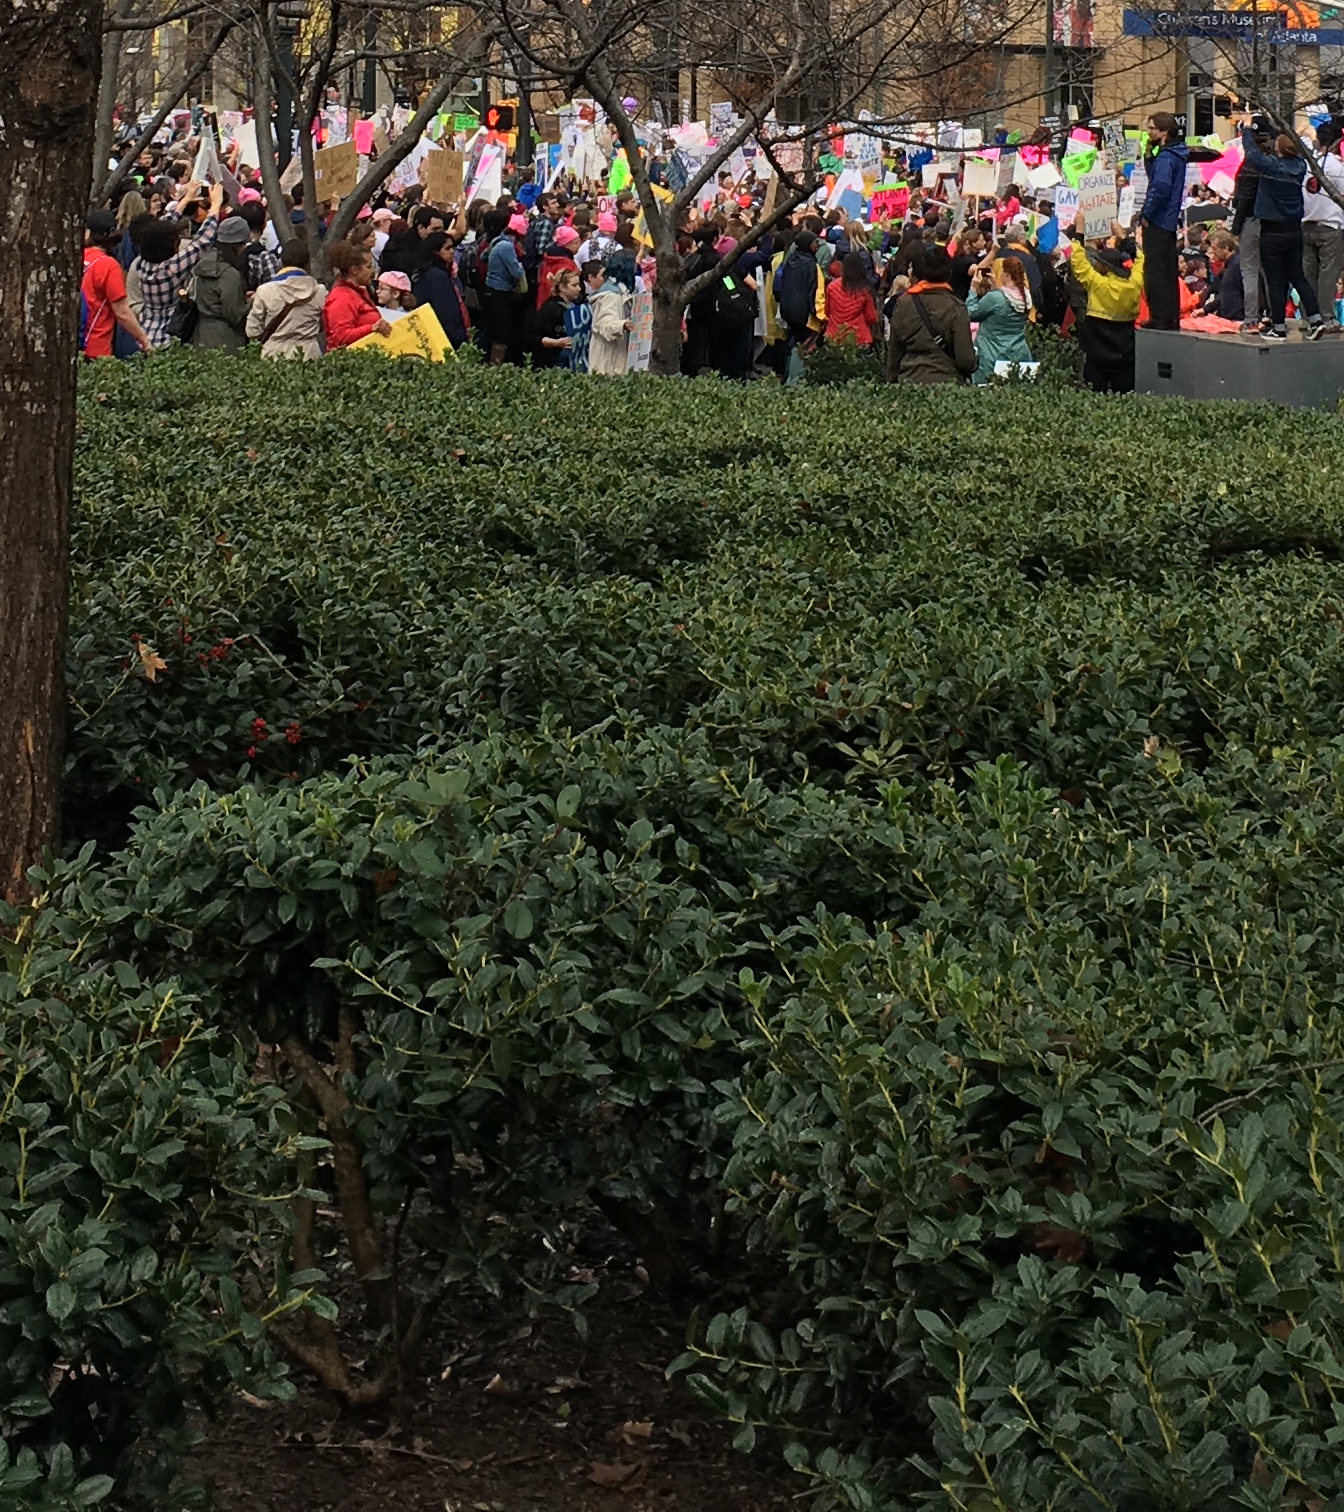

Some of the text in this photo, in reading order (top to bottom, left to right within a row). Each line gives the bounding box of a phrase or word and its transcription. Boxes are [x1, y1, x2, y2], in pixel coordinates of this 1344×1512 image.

[1272, 30, 1317, 43] Atlanta
[1078, 172, 1115, 191] ORGANIZE
[1058, 189, 1079, 206] GAY
[1078, 191, 1115, 211] AGITATE
